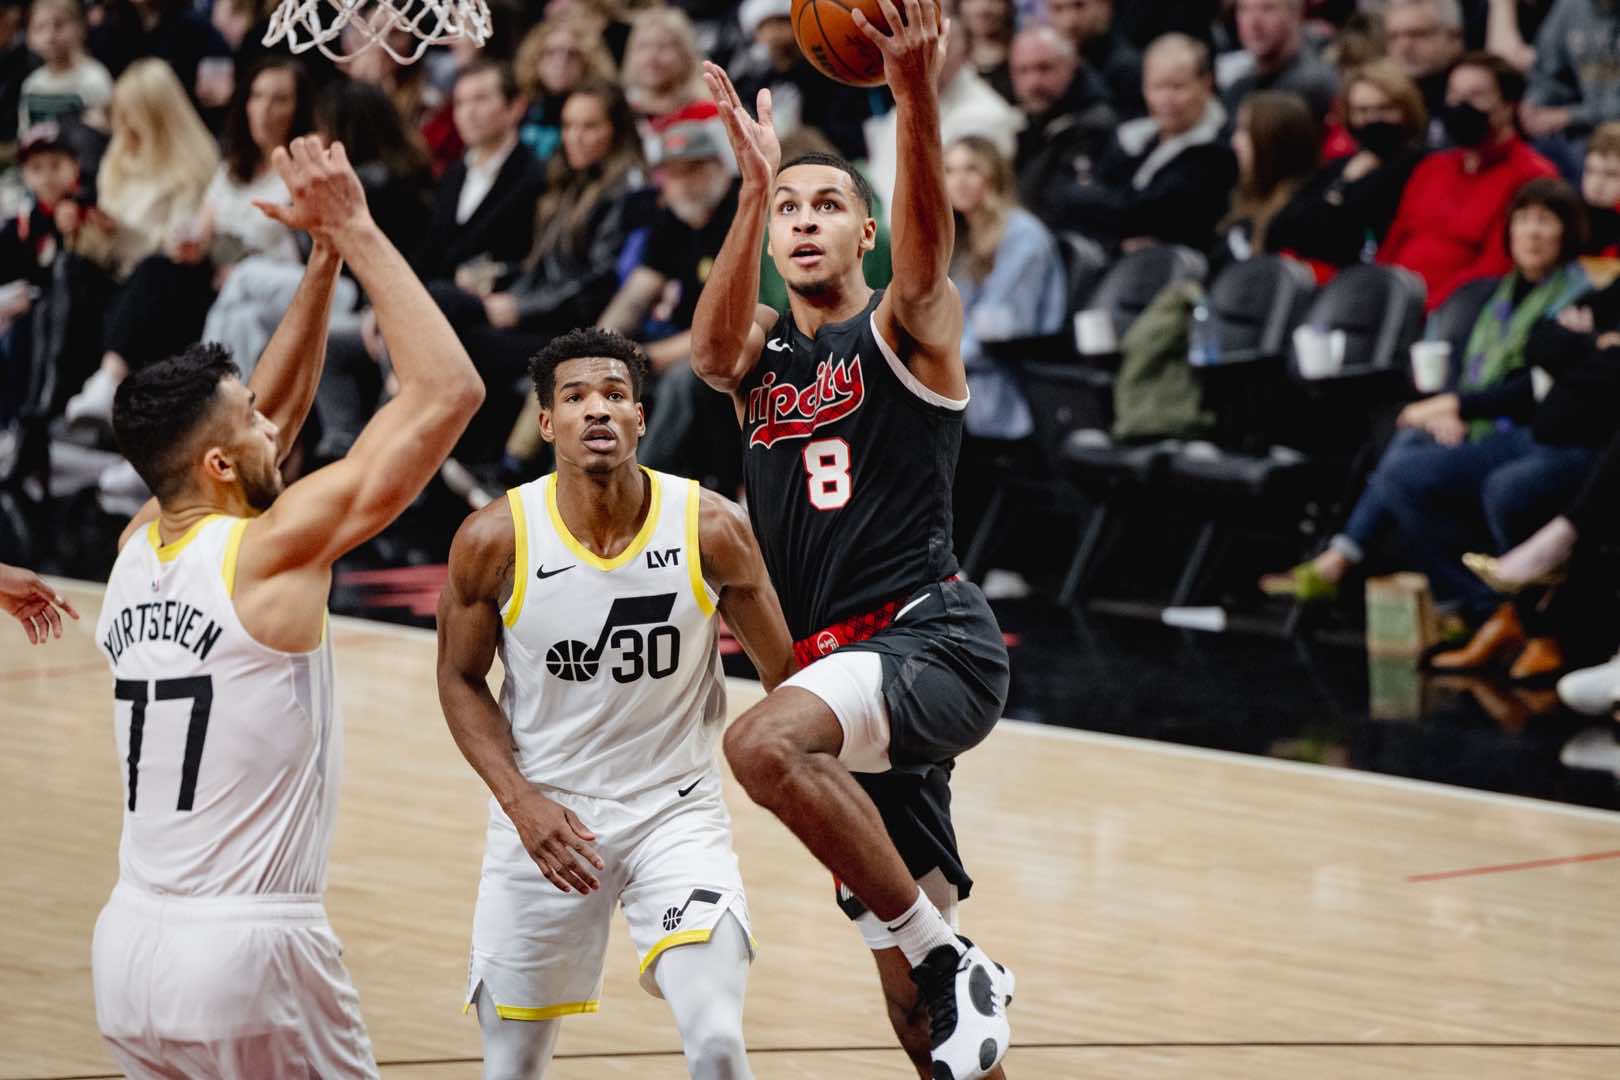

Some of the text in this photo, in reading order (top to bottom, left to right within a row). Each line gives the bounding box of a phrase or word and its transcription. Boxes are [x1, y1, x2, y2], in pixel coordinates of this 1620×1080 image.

[803, 437, 851, 511] 8
[646, 548, 681, 569] LVT
[104, 600, 222, 666] YURTSEVEN
[611, 625, 680, 684] 30
[115, 675, 213, 812] 77
